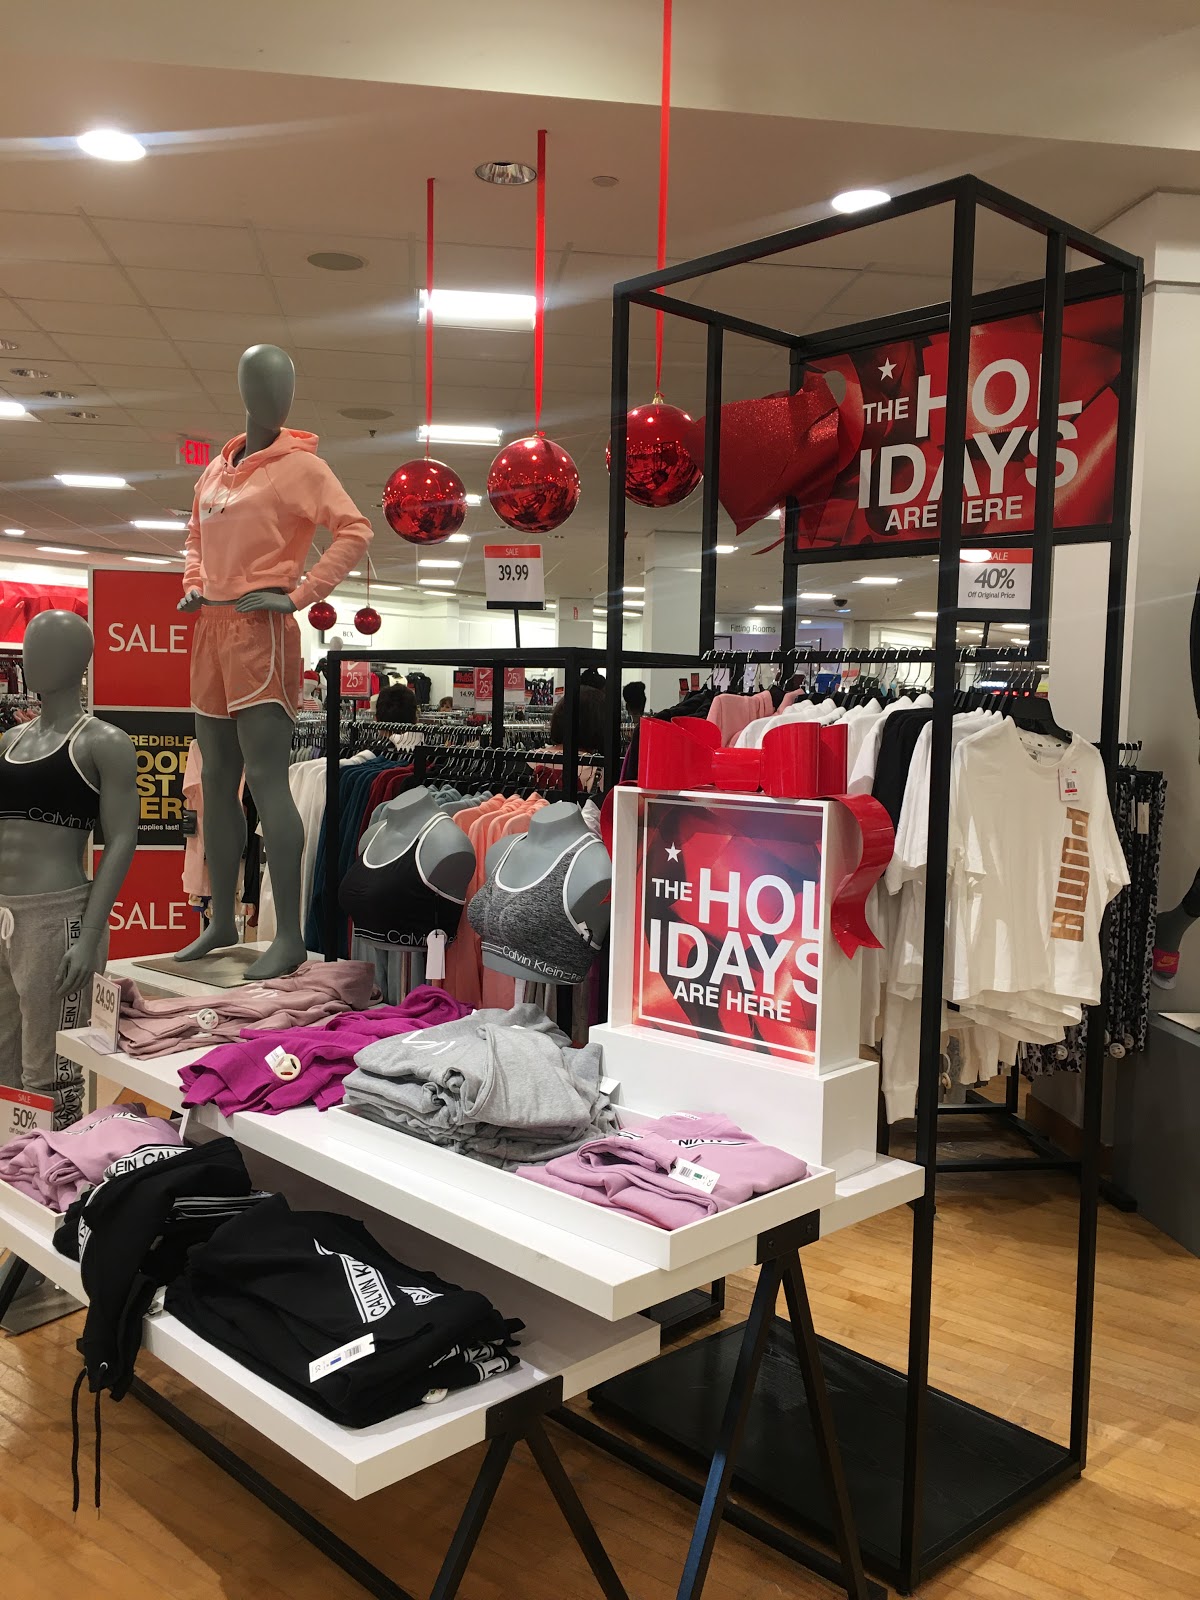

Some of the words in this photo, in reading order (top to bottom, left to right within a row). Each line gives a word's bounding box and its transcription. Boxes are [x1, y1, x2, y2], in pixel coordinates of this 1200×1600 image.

[863, 397, 910, 424] THE
[185, 440, 210, 467] EXIT
[884, 504, 938, 531] ARE
[961, 495, 1023, 524] ERE
[505, 547, 519, 556] SALE
[498, 564, 529, 581] 39.99
[974, 567, 1016, 589] 40%
[977, 591, 1000, 599] Original
[1000, 591, 1016, 599] Price
[108, 622, 188, 654] SALE
[730, 623, 751, 633] Fitting
[752, 624, 776, 633] Rooms
[131, 735, 194, 747] REDIBLE
[136, 774, 176, 797] ST
[28, 807, 82, 828] Calvin
[1050, 806, 1090, 942] PUMA
[652, 877, 693, 902] THE
[109, 901, 187, 930] SALE
[502, 946, 531, 967] Calvin
[533, 960, 564, 979] Klein
[649, 918, 821, 1005] IDAYS
[95, 983, 115, 1013] 24.99
[673, 980, 720, 1008] ARE
[726, 990, 792, 1023] HERE
[18, 1094, 31, 1104] SALE
[13, 1107, 38, 1129] 50%
[358, 1278, 387, 1317] CALVIN
